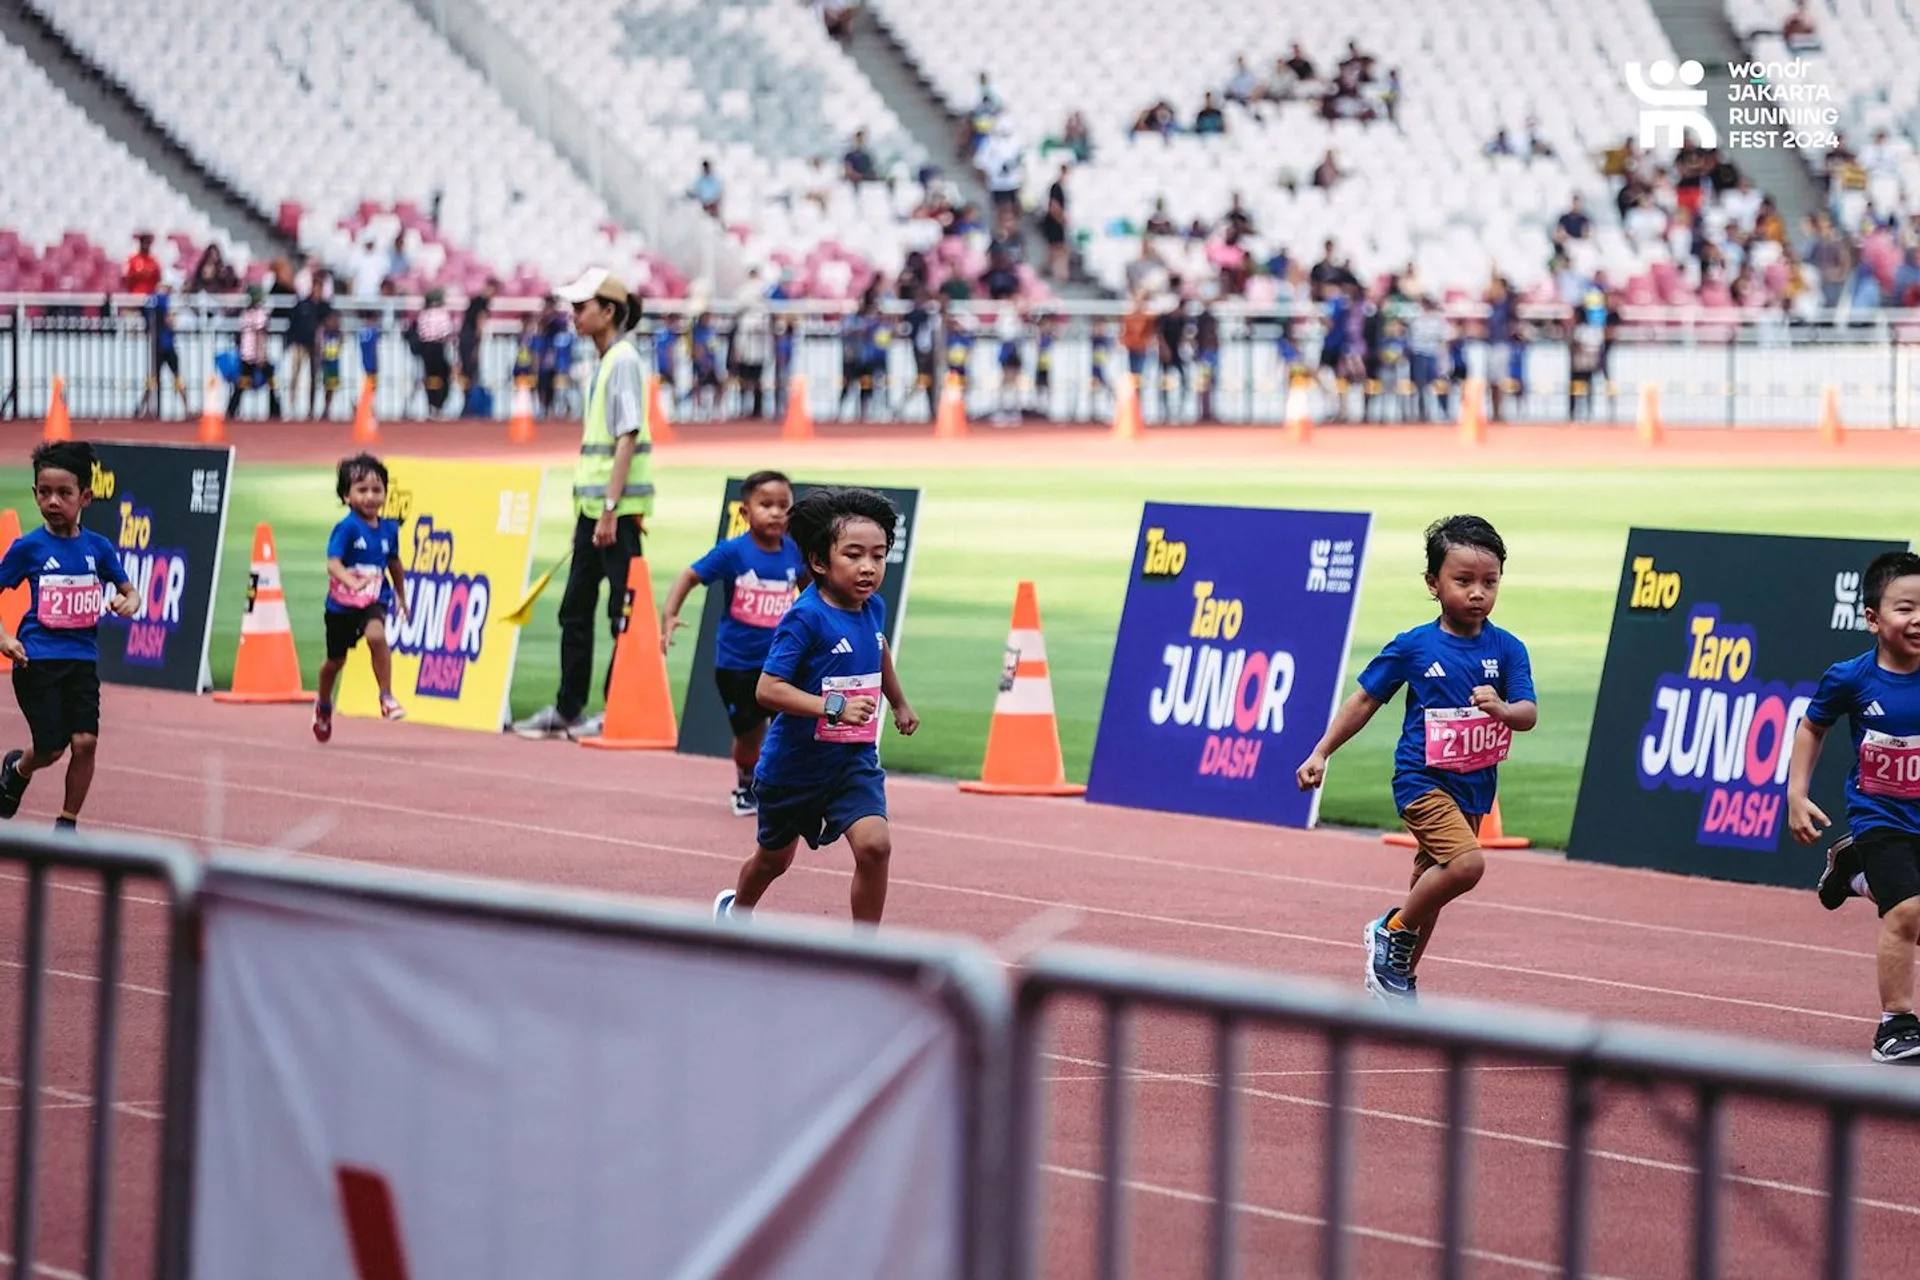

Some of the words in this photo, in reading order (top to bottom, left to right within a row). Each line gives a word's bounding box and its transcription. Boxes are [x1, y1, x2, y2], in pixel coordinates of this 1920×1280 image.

[118, 502, 151, 550] Taro
[414, 523, 450, 575] Taro
[1143, 528, 1187, 576] Taro
[51, 589, 100, 615] 21050
[1630, 556, 1681, 609] Taro
[1189, 581, 1243, 640] Taro
[127, 622, 167, 659] DASH
[1688, 617, 1751, 683] Taro
[419, 653, 465, 692] DASH
[1149, 644, 1295, 733] JUNIOR
[1198, 735, 1262, 779] DASH
[1442, 721, 1508, 757] 21052
[1704, 789, 1780, 838] DASH
